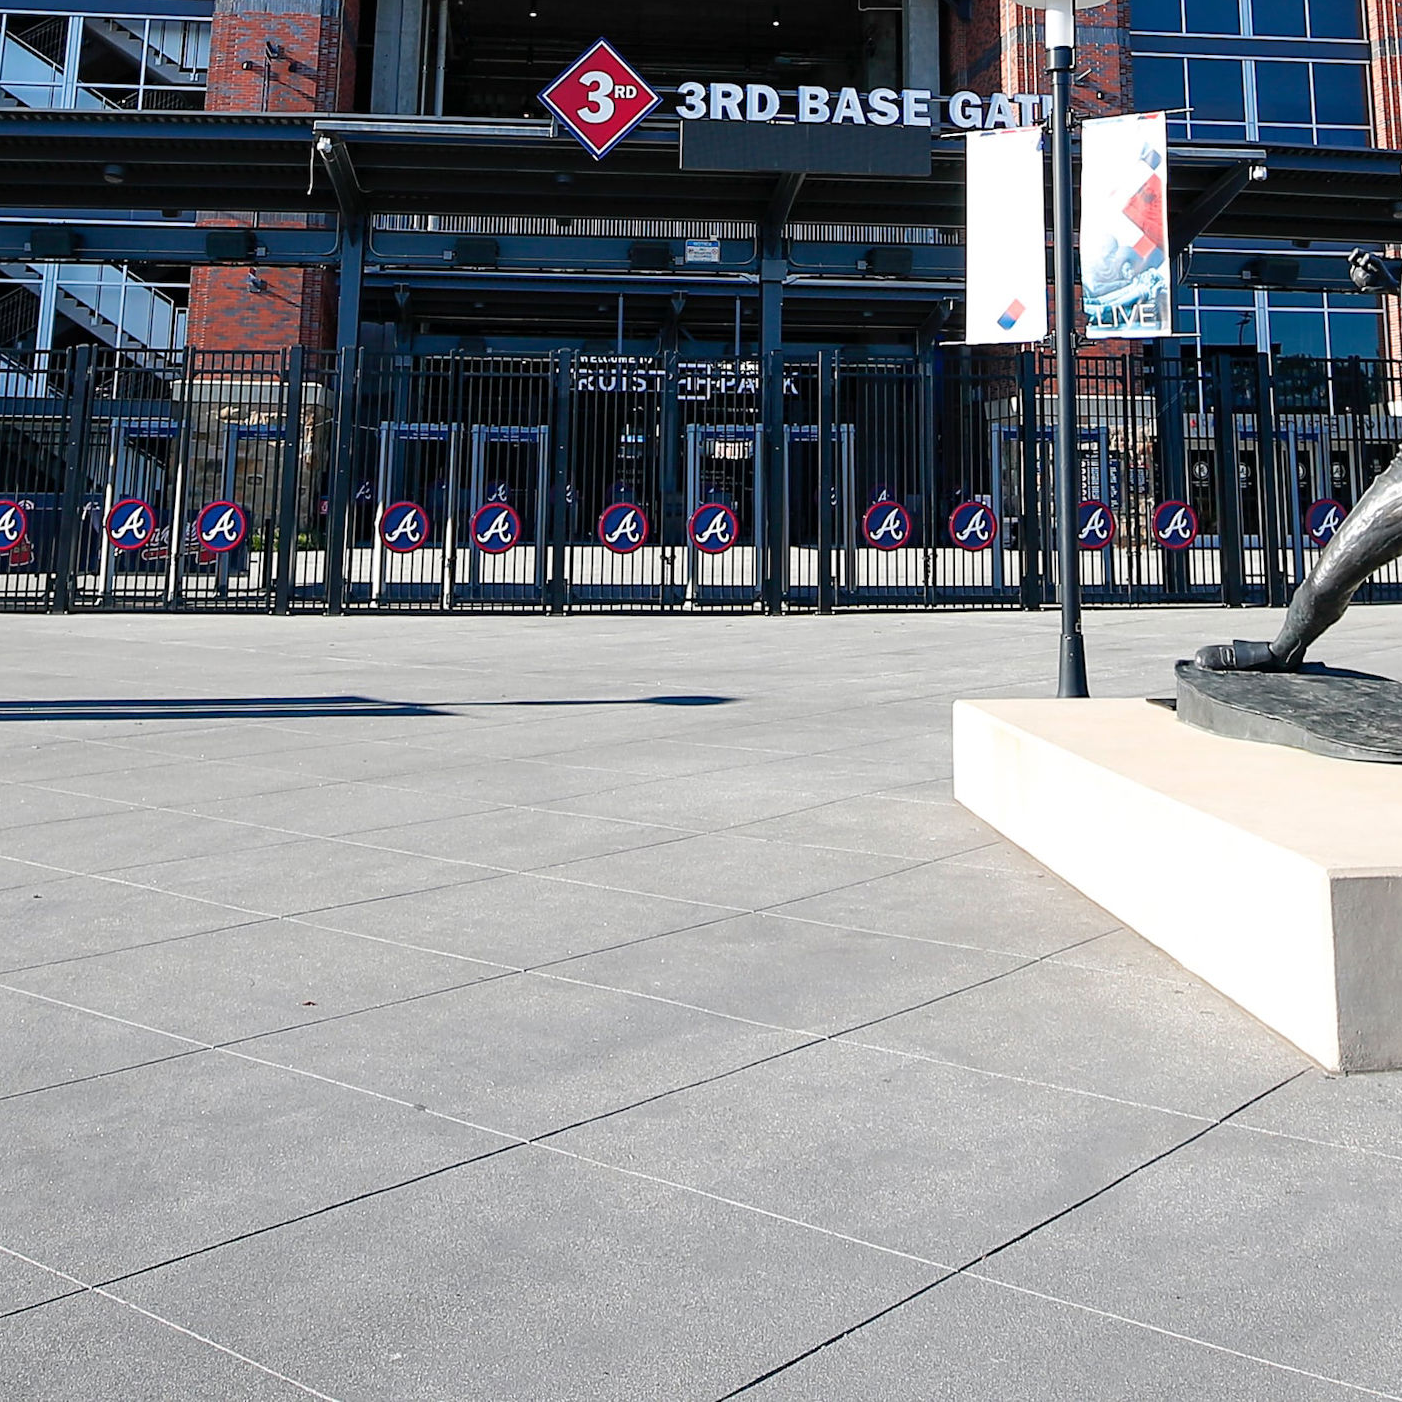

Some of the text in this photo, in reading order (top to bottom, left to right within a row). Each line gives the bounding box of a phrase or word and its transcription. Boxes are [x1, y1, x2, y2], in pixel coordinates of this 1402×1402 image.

[675, 81, 782, 122] 3RD
[798, 84, 932, 128] BASE
[1095, 302, 1157, 329] LIVE
[112, 506, 146, 540] A
[204, 508, 237, 541] A
[385, 509, 420, 542] A
[477, 510, 512, 543] A
[605, 510, 640, 543] A
[695, 510, 730, 543] A
[869, 507, 903, 541] A
[955, 508, 989, 541] A
[1078, 507, 1108, 539] A
[1158, 507, 1191, 539] A
